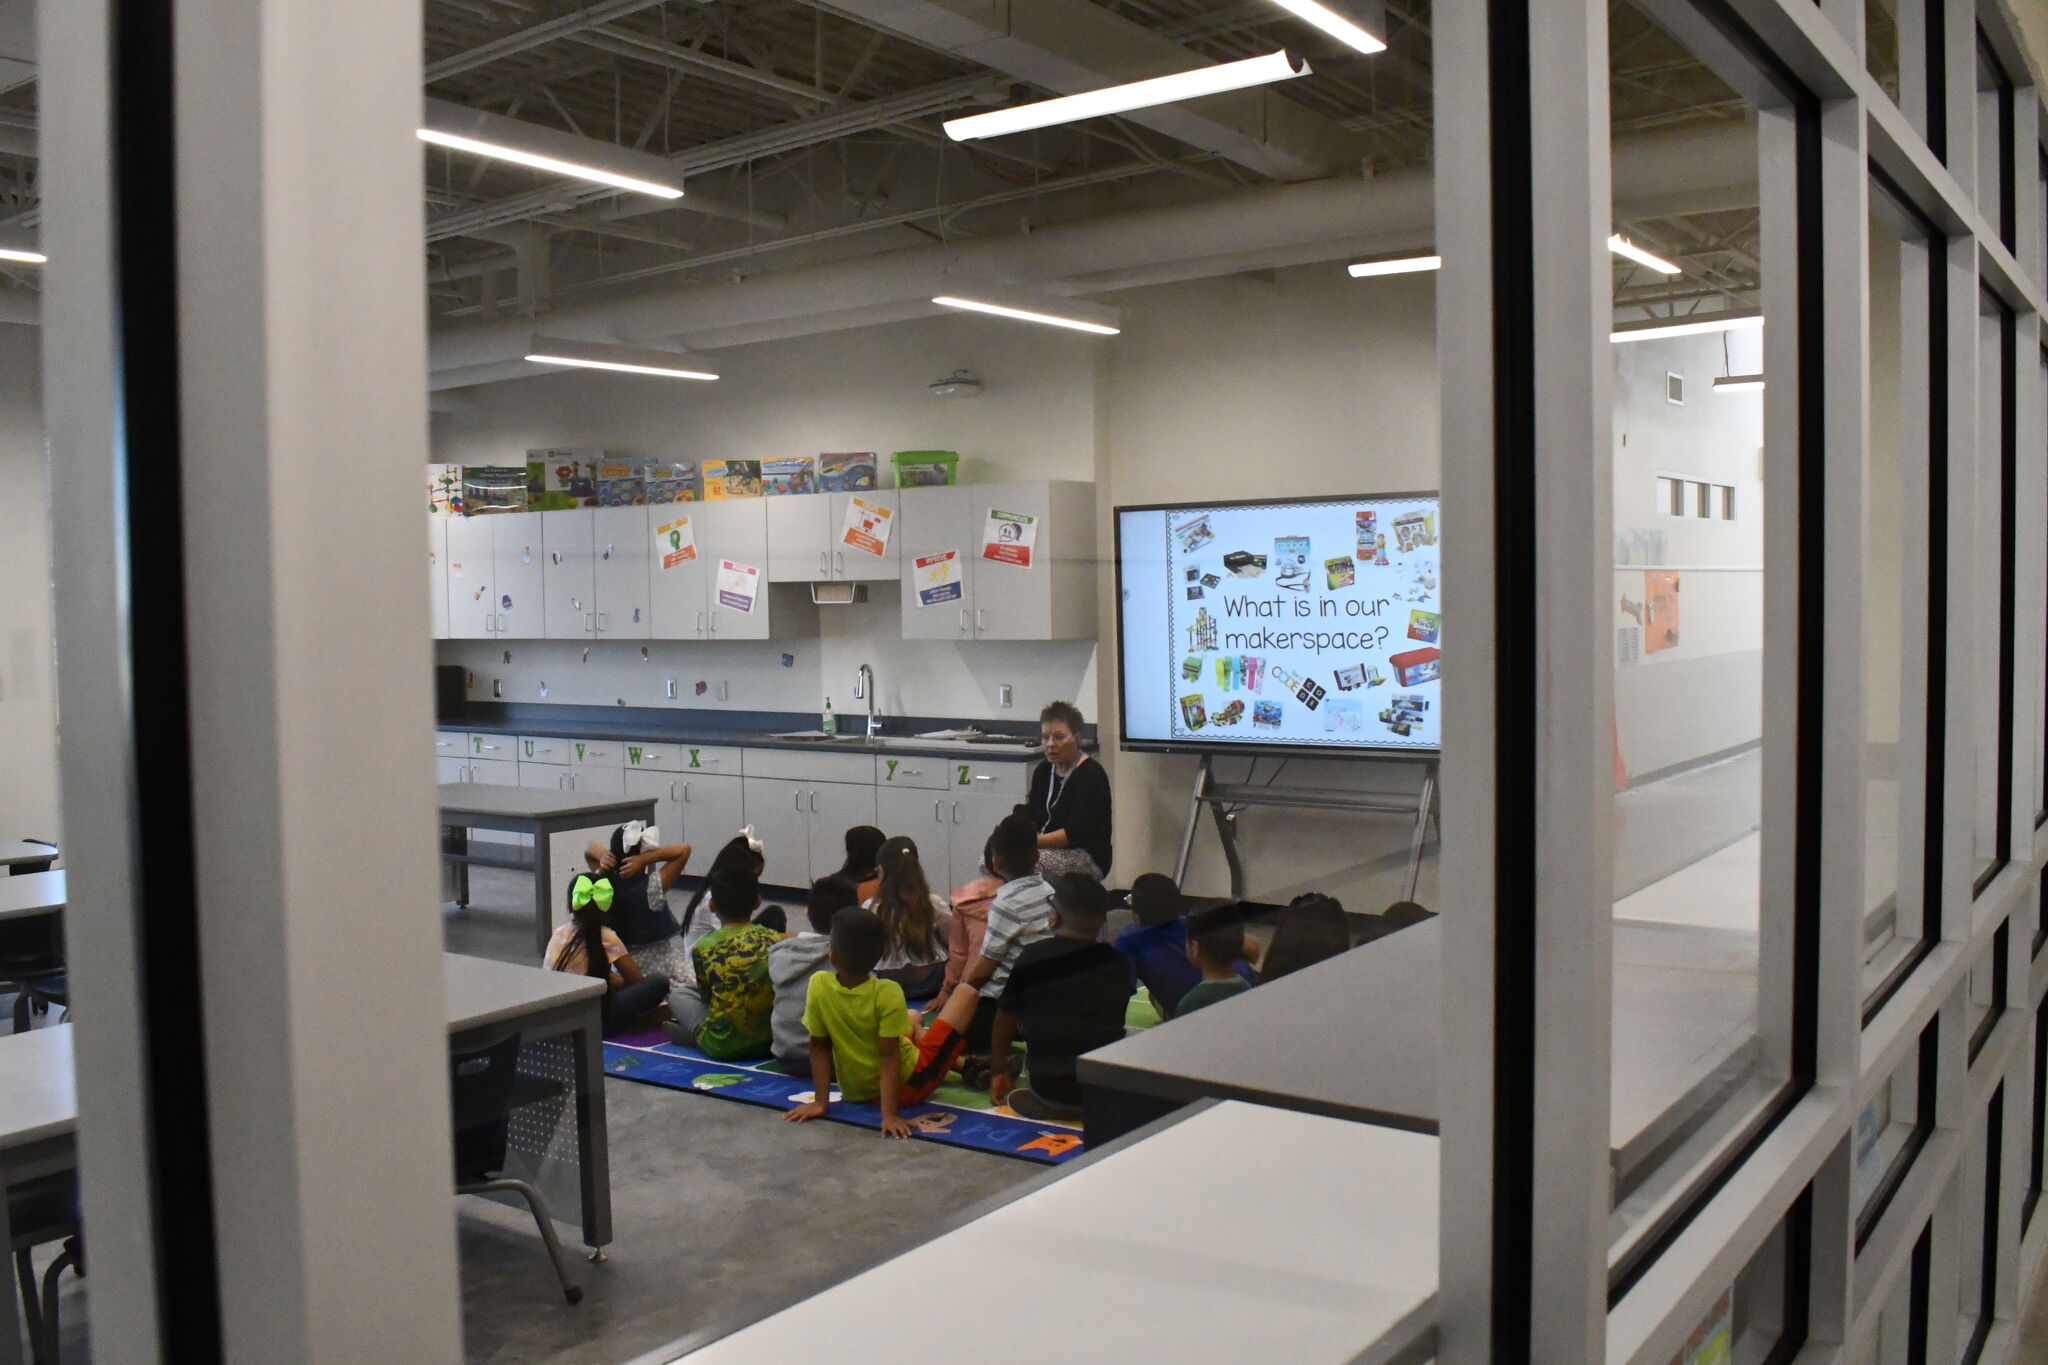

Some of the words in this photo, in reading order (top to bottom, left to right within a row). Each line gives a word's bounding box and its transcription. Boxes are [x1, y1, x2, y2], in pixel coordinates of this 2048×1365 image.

[1223, 594, 1287, 617] What
[1294, 596, 1312, 618] is
[1319, 596, 1337, 618] in
[1346, 599, 1390, 618] our
[1225, 625, 1390, 656] makerspace?
[473, 736, 483, 753] T
[524, 740, 534, 758] U
[575, 743, 586, 761] V
[628, 746, 642, 766] W
[689, 748, 701, 768] X
[886, 760, 898, 781] Y
[957, 765, 971, 785] Z
